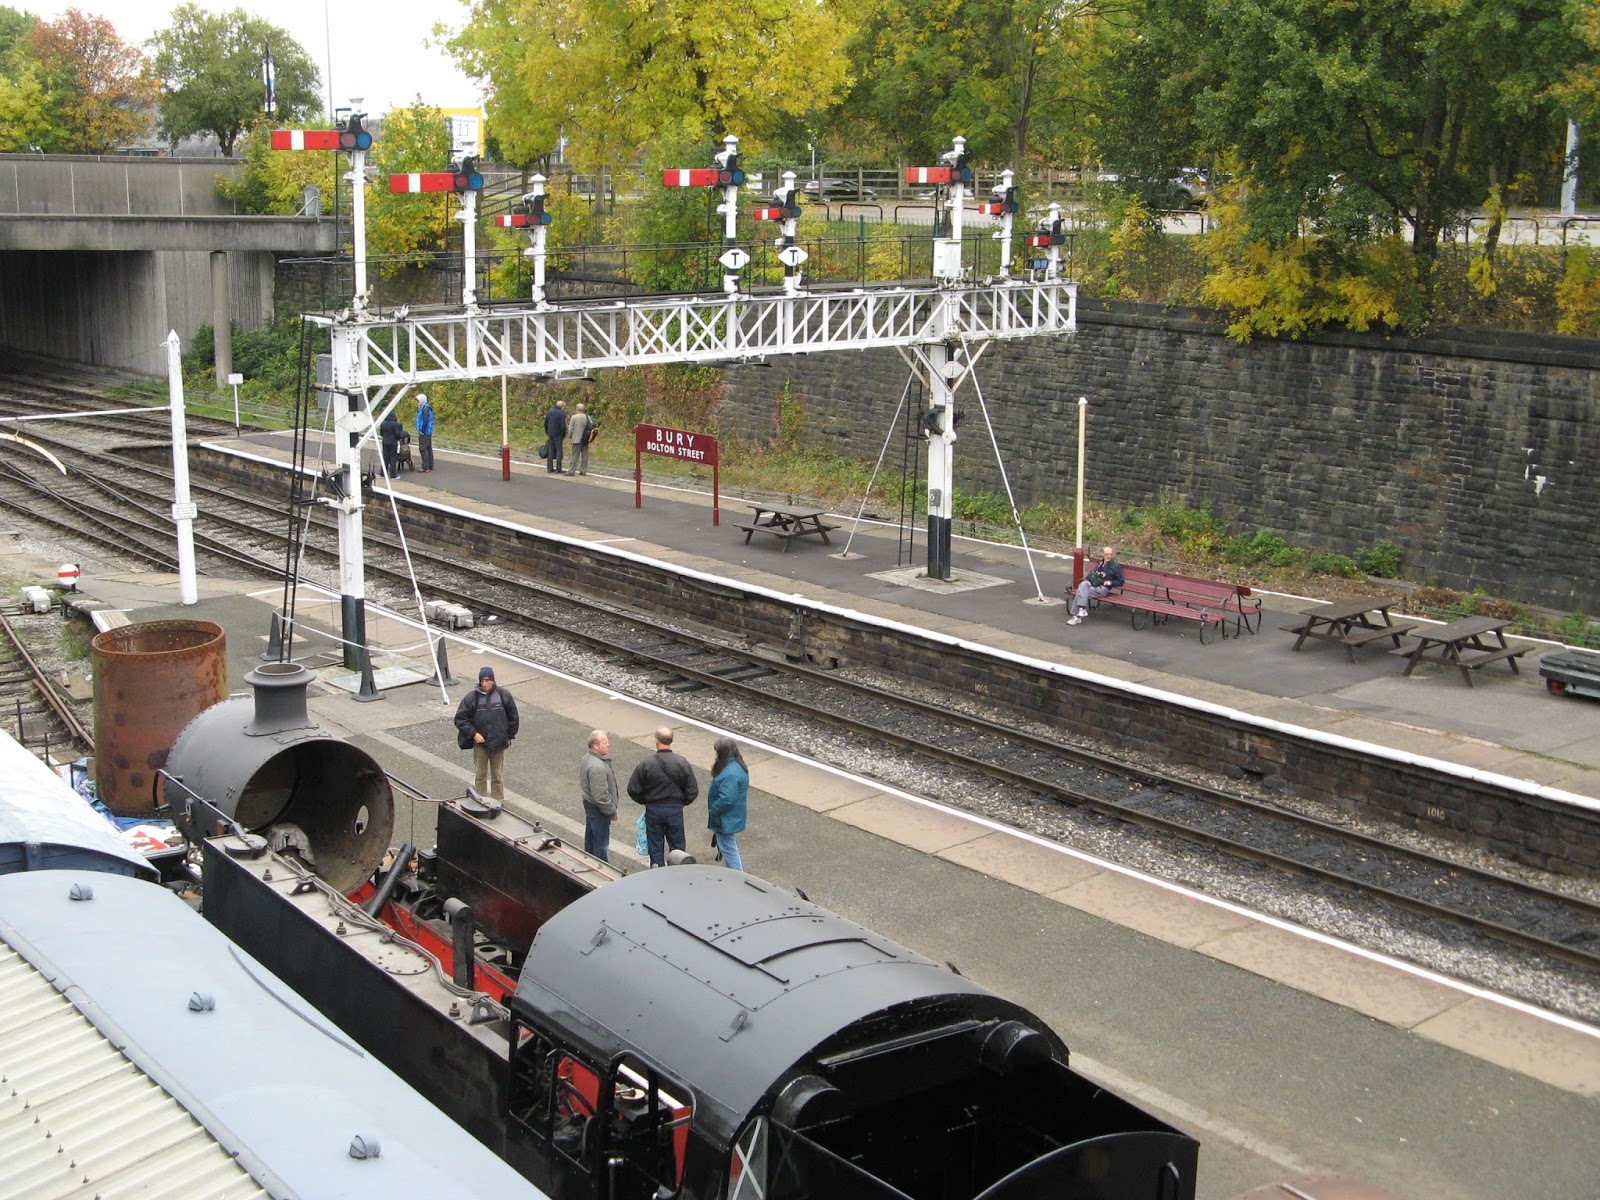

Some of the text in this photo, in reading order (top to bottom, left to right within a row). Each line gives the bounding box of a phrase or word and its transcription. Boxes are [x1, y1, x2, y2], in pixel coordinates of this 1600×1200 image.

[731, 252, 740, 266] T
[789, 249, 798, 263] T
[656, 429, 695, 447] BURY
[646, 441, 705, 460] BOLTON STREET
